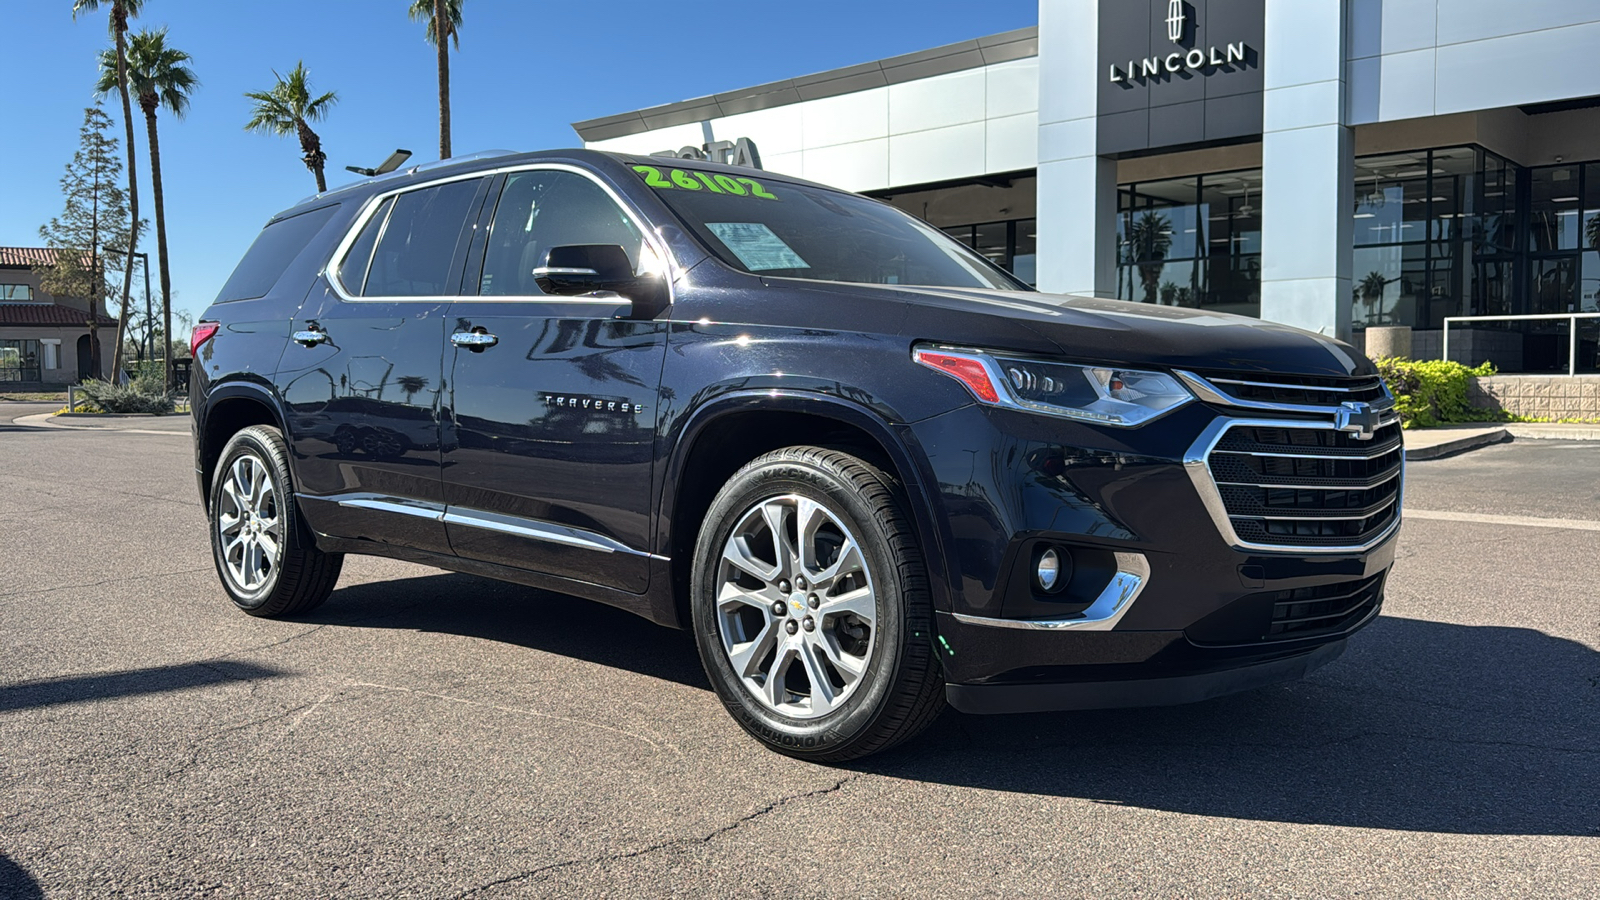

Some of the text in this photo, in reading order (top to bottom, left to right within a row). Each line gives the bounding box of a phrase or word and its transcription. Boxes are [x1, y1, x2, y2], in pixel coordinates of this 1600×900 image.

[1109, 41, 1244, 82] LINCOLN
[632, 165, 779, 201] 26102
[545, 395, 643, 414] TRAVERSE
[741, 711, 828, 748] YOKOHAMA
